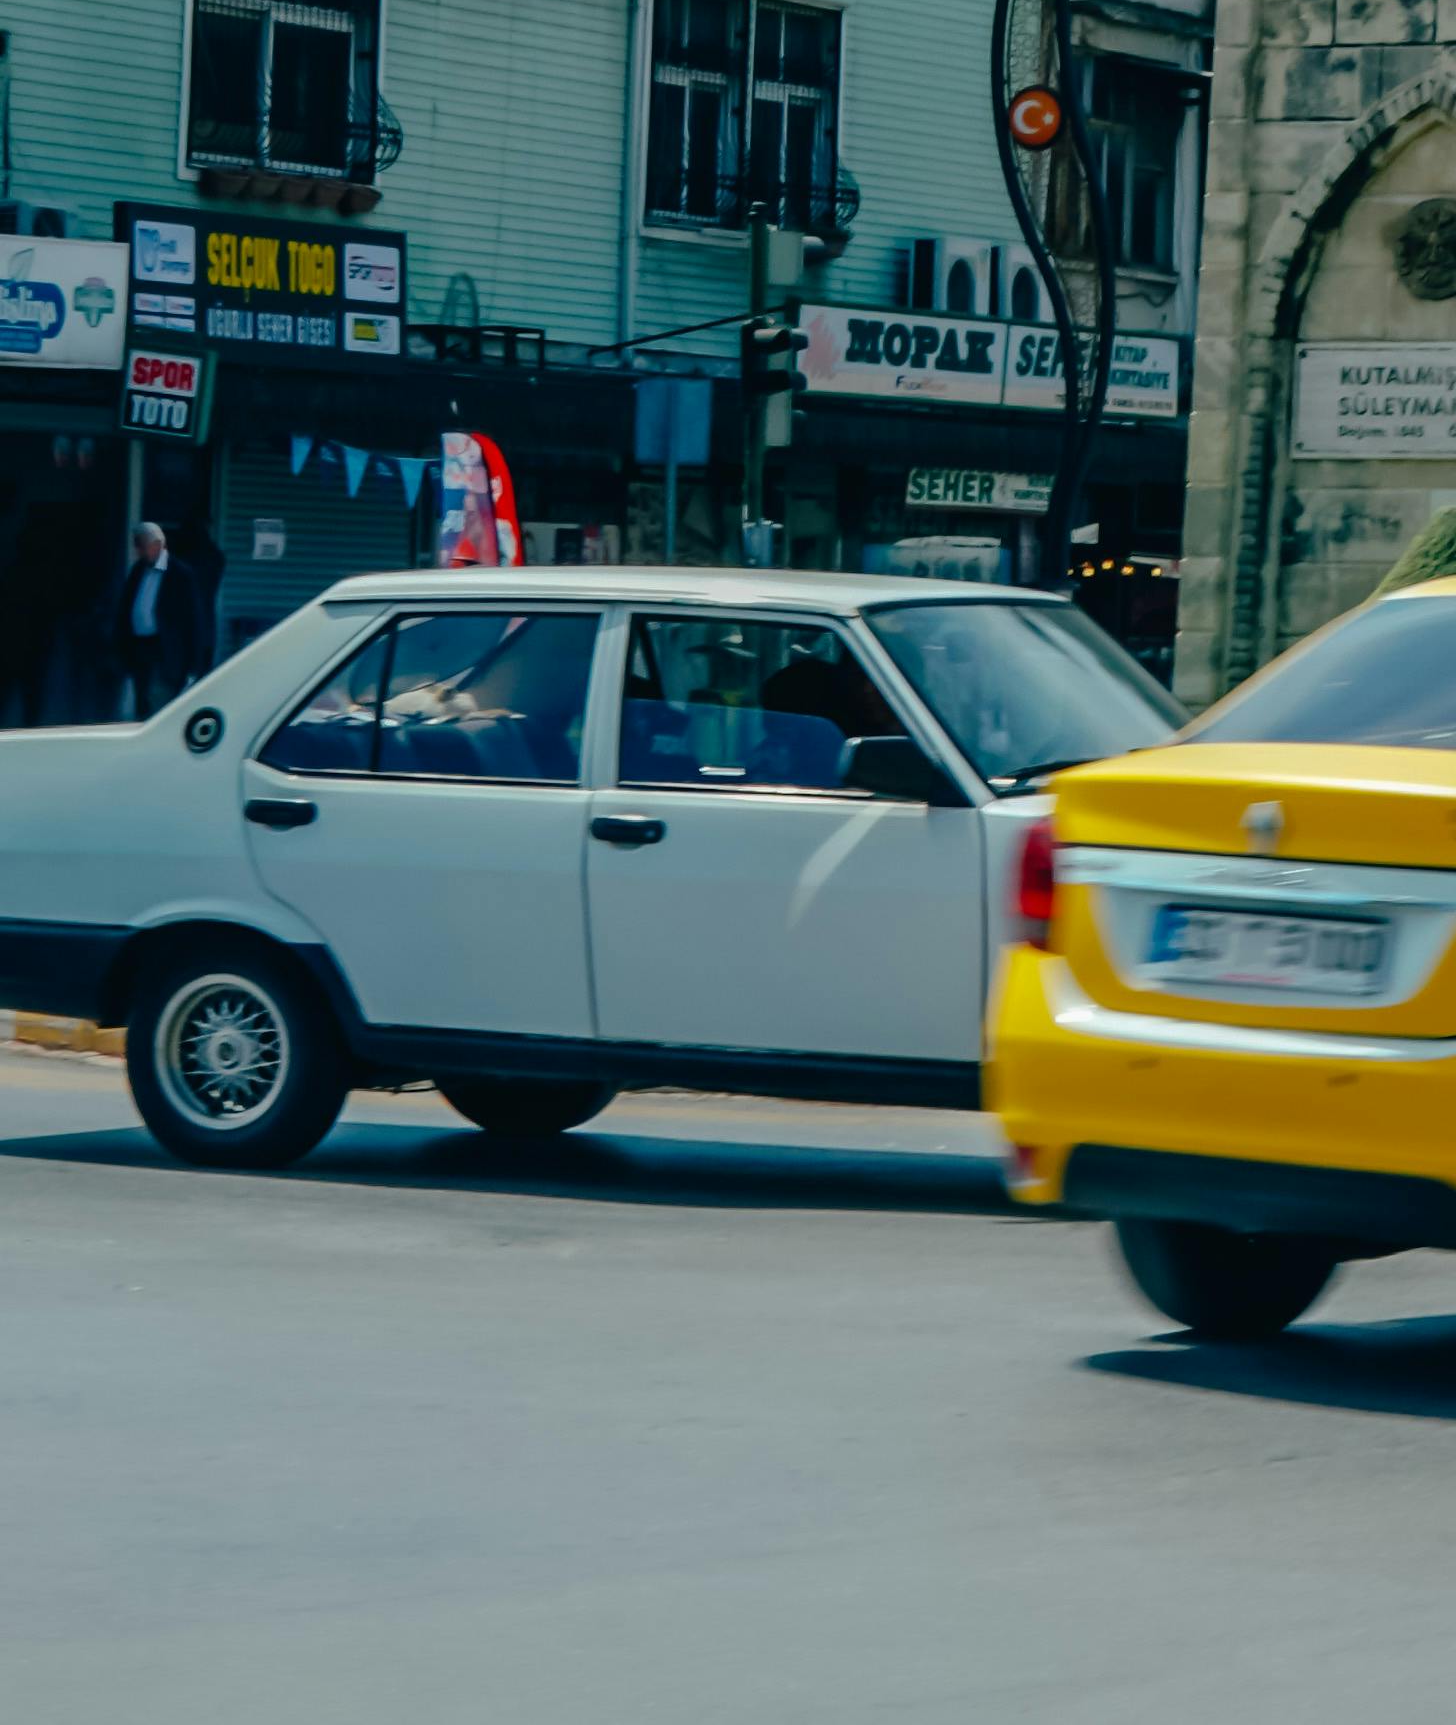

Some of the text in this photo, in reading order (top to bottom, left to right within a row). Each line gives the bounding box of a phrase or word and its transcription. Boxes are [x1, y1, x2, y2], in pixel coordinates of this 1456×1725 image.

[845, 318, 995, 374] MOPAK
[132, 357, 194, 391] SPOR
[131, 394, 188, 429] TOTO
[909, 470, 995, 503] SEHER
